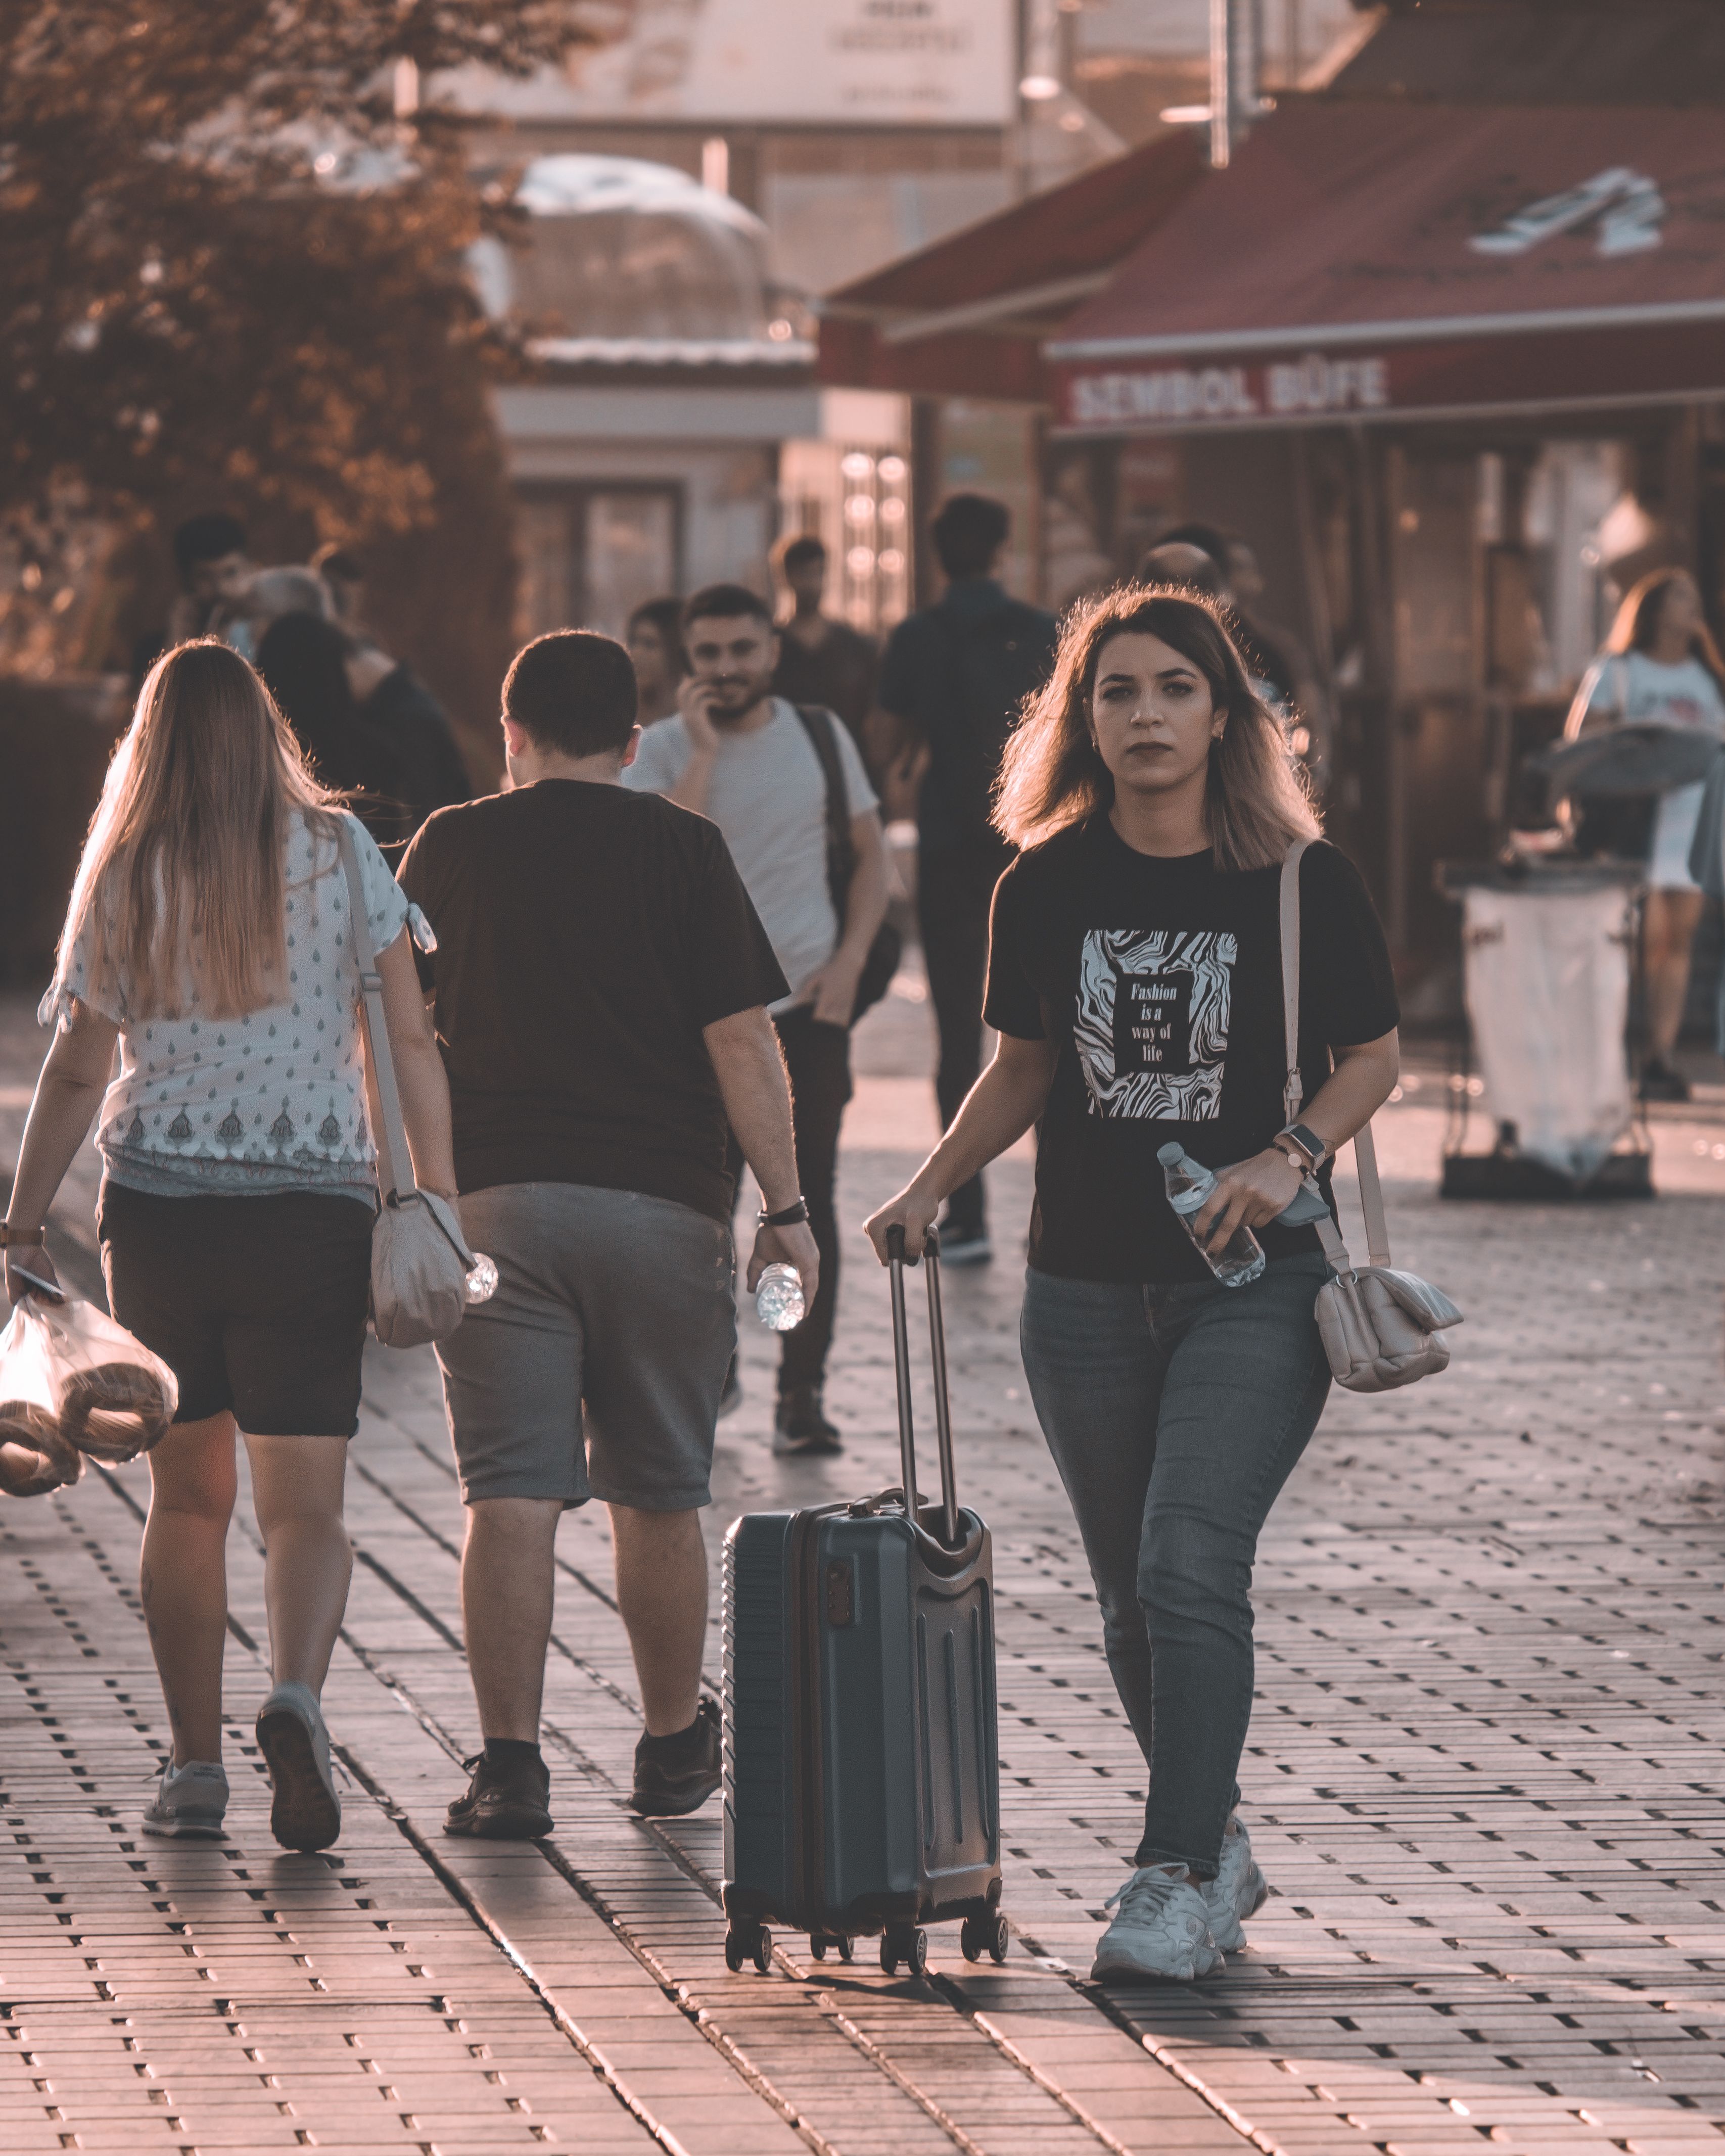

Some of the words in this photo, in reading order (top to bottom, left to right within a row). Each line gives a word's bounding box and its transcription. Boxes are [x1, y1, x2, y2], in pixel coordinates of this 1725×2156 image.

[1069, 369, 1258, 424] SEMBOL
[1131, 982, 1177, 1000] Fashion
[1141, 1003, 1151, 1020] is
[1154, 1007, 1161, 1021] a
[1132, 1026, 1155, 1043] way
[1160, 1023, 1171, 1040] of
[1143, 1044, 1162, 1061] life
